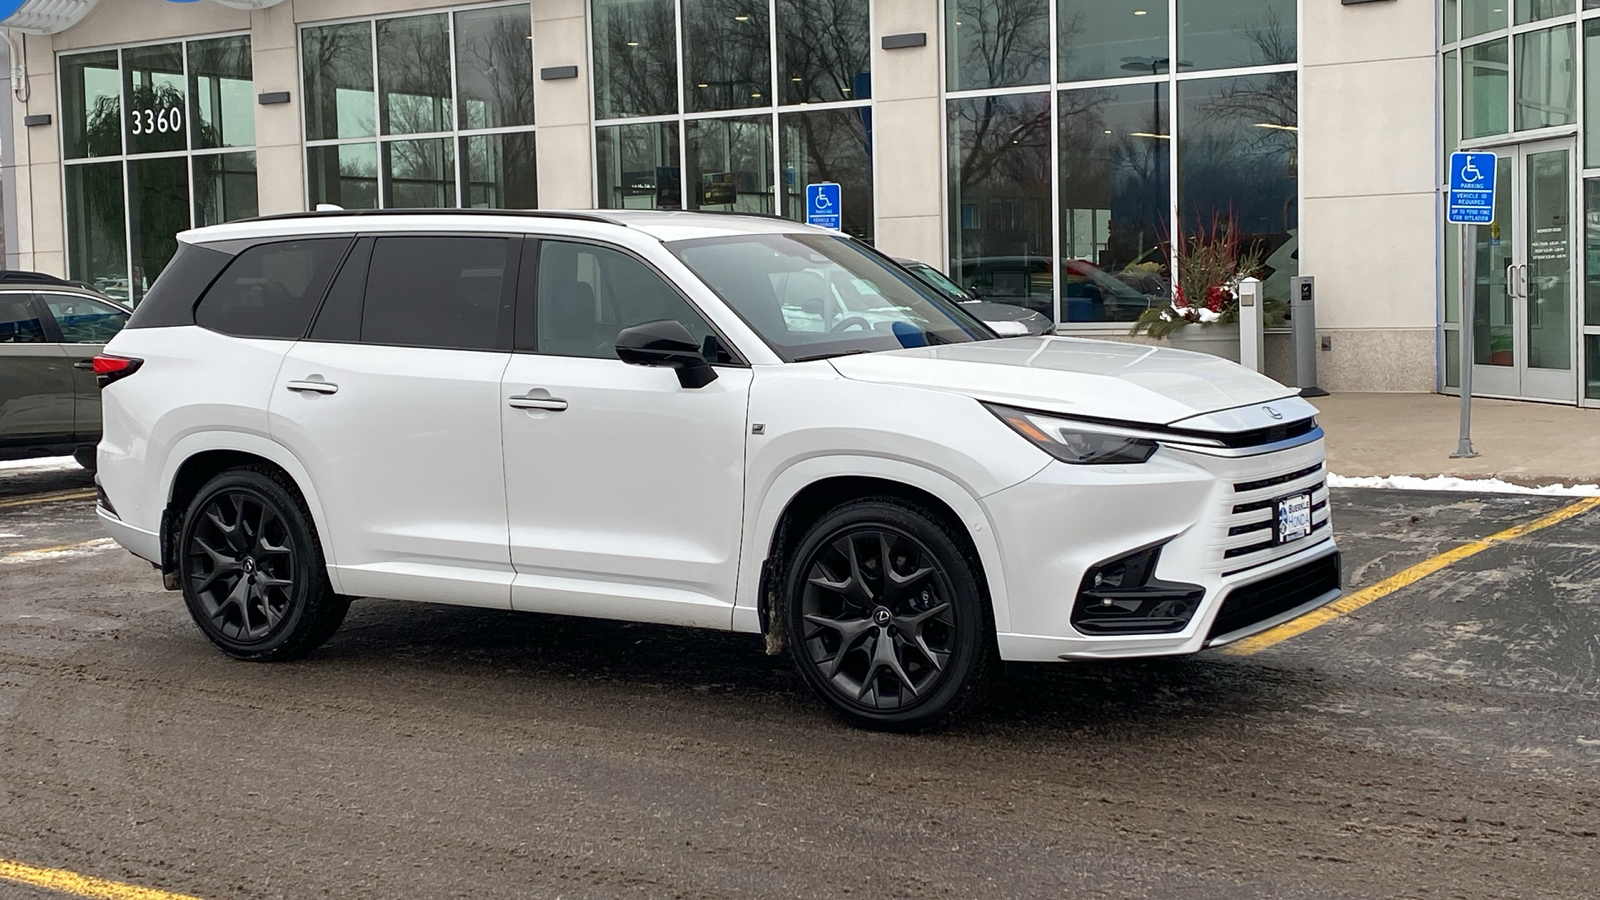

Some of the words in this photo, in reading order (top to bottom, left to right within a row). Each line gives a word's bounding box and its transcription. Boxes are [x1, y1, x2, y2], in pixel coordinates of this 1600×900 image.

[131, 106, 181, 135] 3360
[1288, 500, 1310, 514] BUERKLE
[1288, 512, 1310, 530] HONDA
